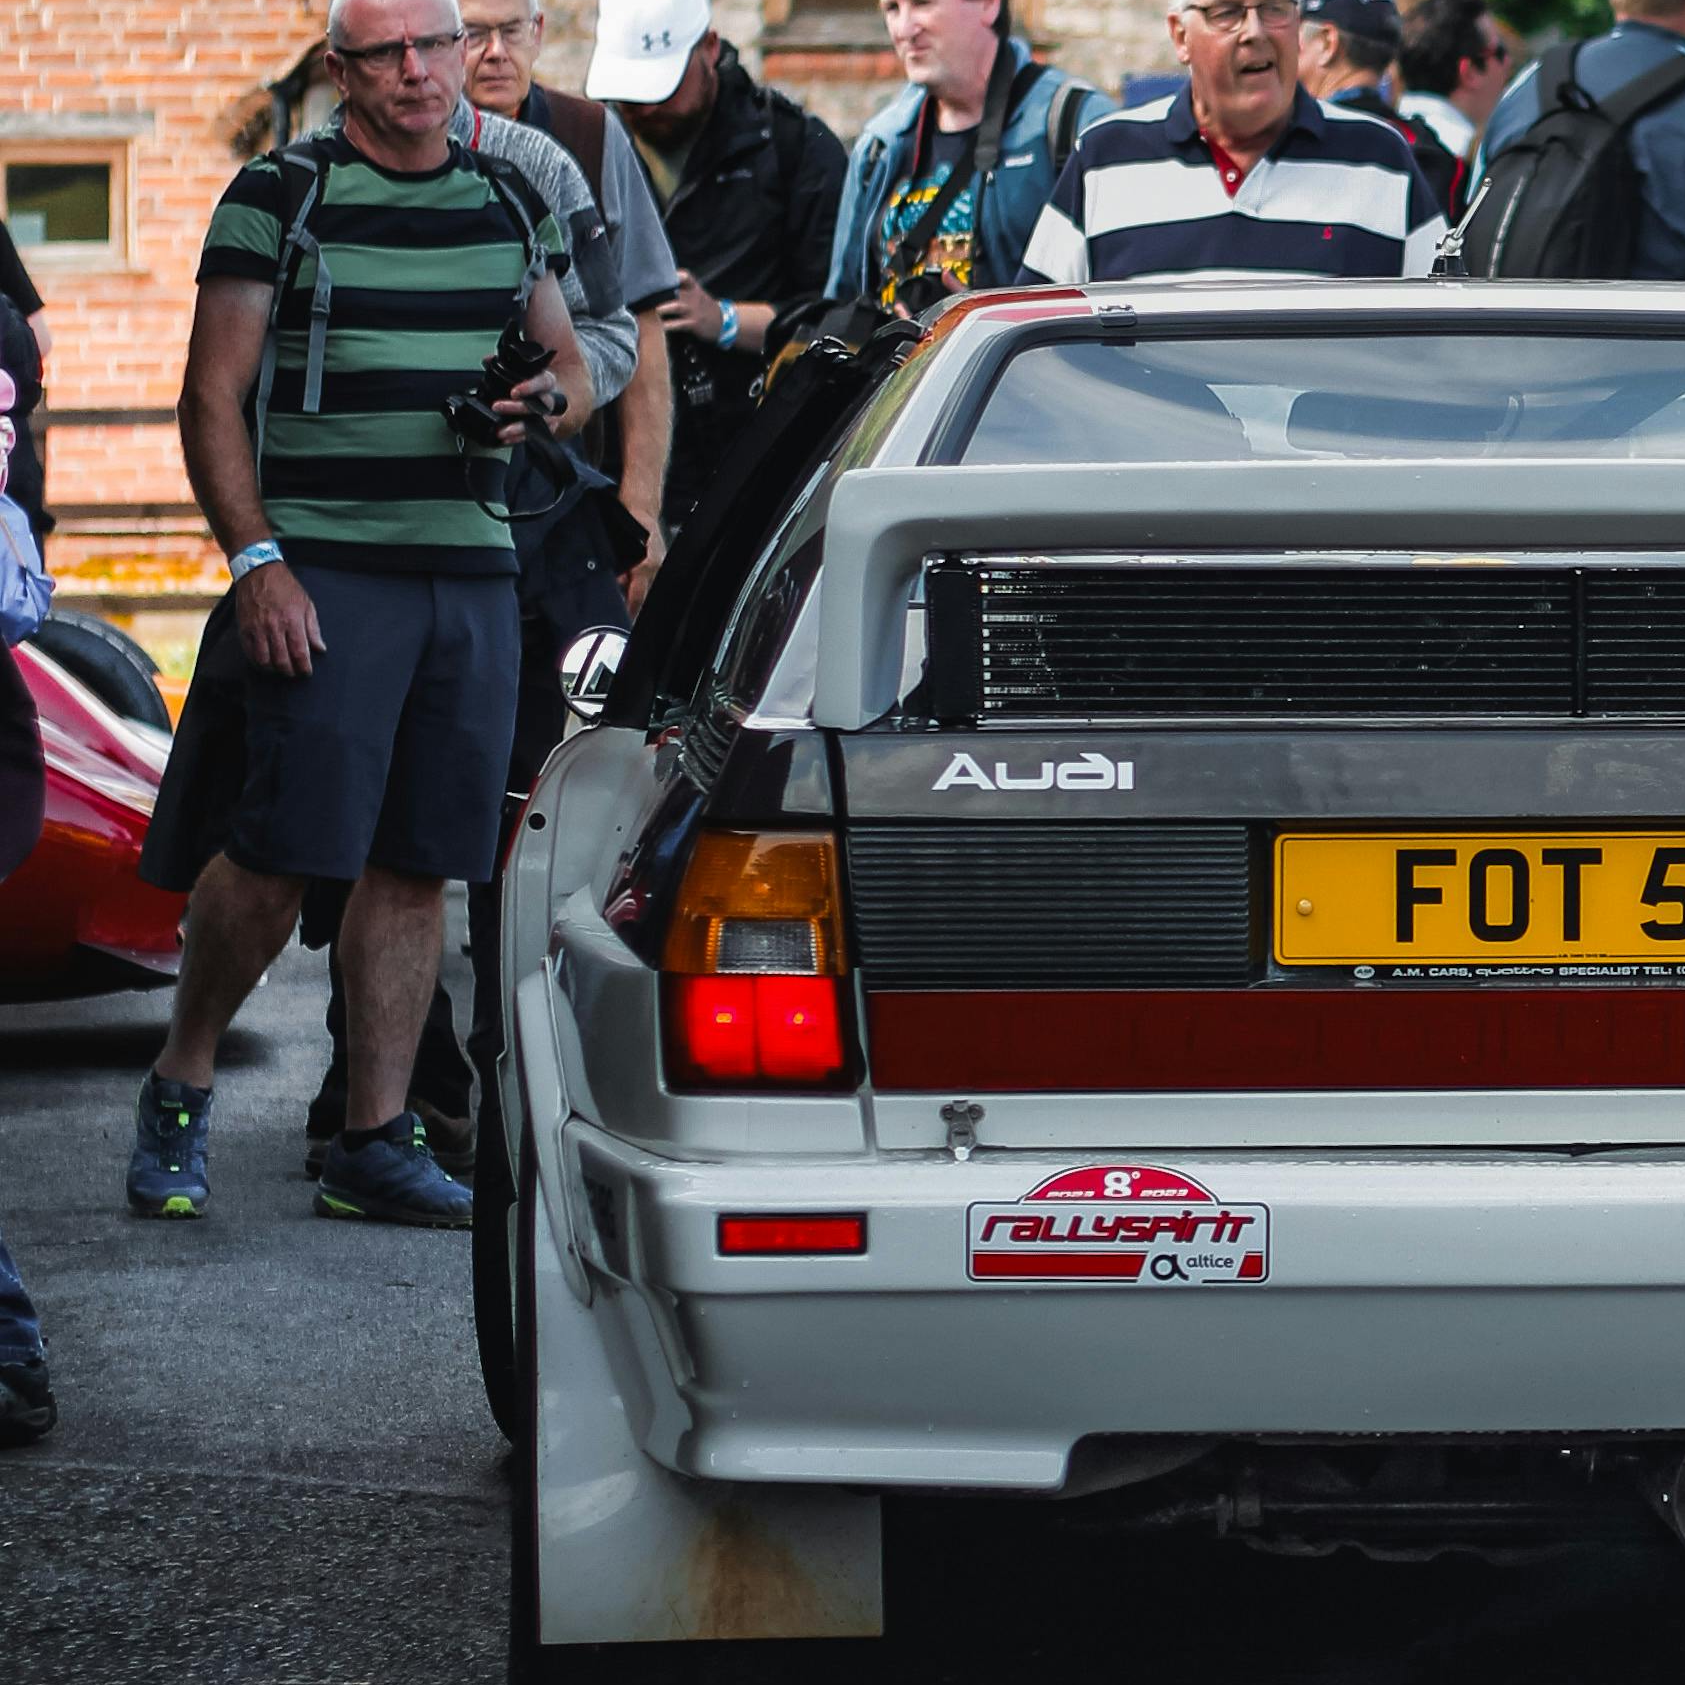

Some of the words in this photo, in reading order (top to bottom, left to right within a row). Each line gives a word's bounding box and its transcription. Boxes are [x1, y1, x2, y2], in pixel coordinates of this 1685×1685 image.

[931, 752, 1134, 791] Audi
[1396, 847, 1604, 943] FOT
[1391, 967, 1425, 977] A.M.
[1428, 967, 1473, 978] CARS,
[1475, 966, 1554, 977] quattro
[1558, 966, 1640, 976] SPECIALIST
[1642, 966, 1672, 976] TEL:
[1186, 1253, 1235, 1270] altice
